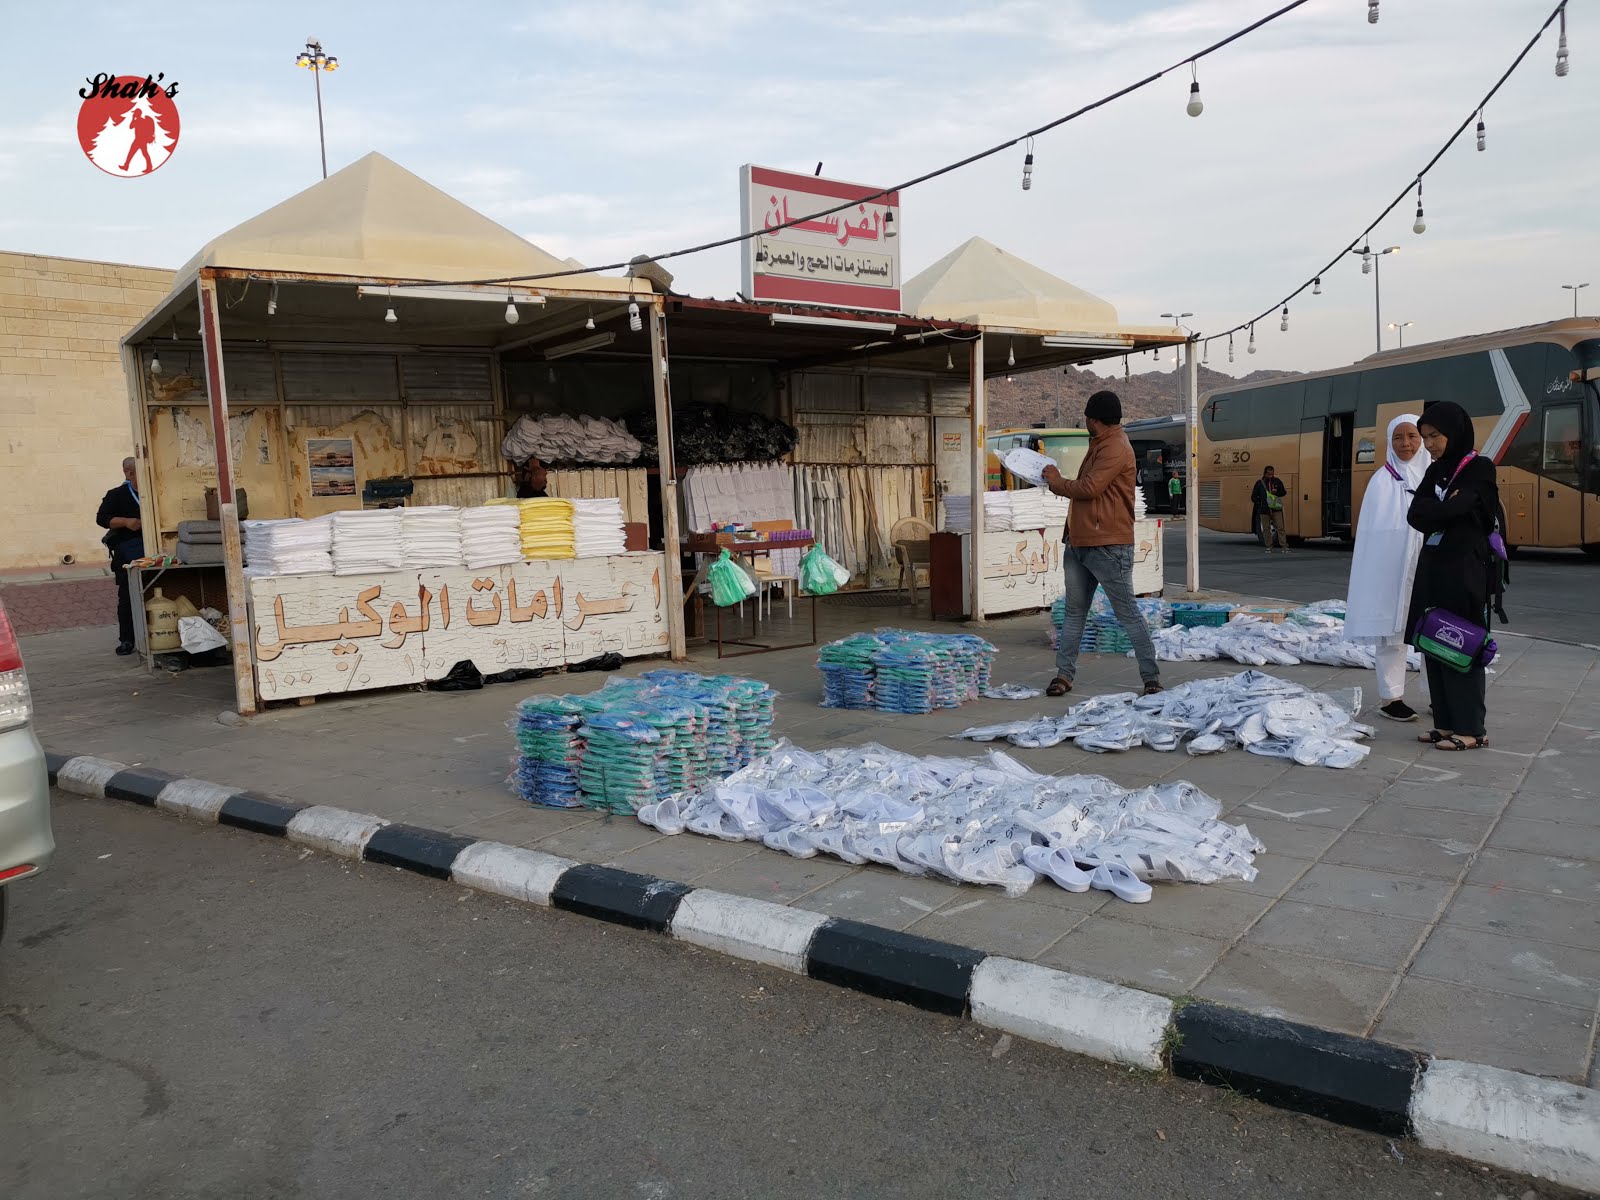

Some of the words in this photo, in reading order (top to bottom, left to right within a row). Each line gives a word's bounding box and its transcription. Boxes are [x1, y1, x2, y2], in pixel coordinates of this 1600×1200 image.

[764, 194, 888, 247] الفرسان
[762, 244, 805, 271] والعمرة
[806, 253, 833, 273] الحج
[833, 255, 889, 278] لمستلزمات
[984, 539, 1057, 589] الوكي
[256, 583, 450, 661] الوكيل
